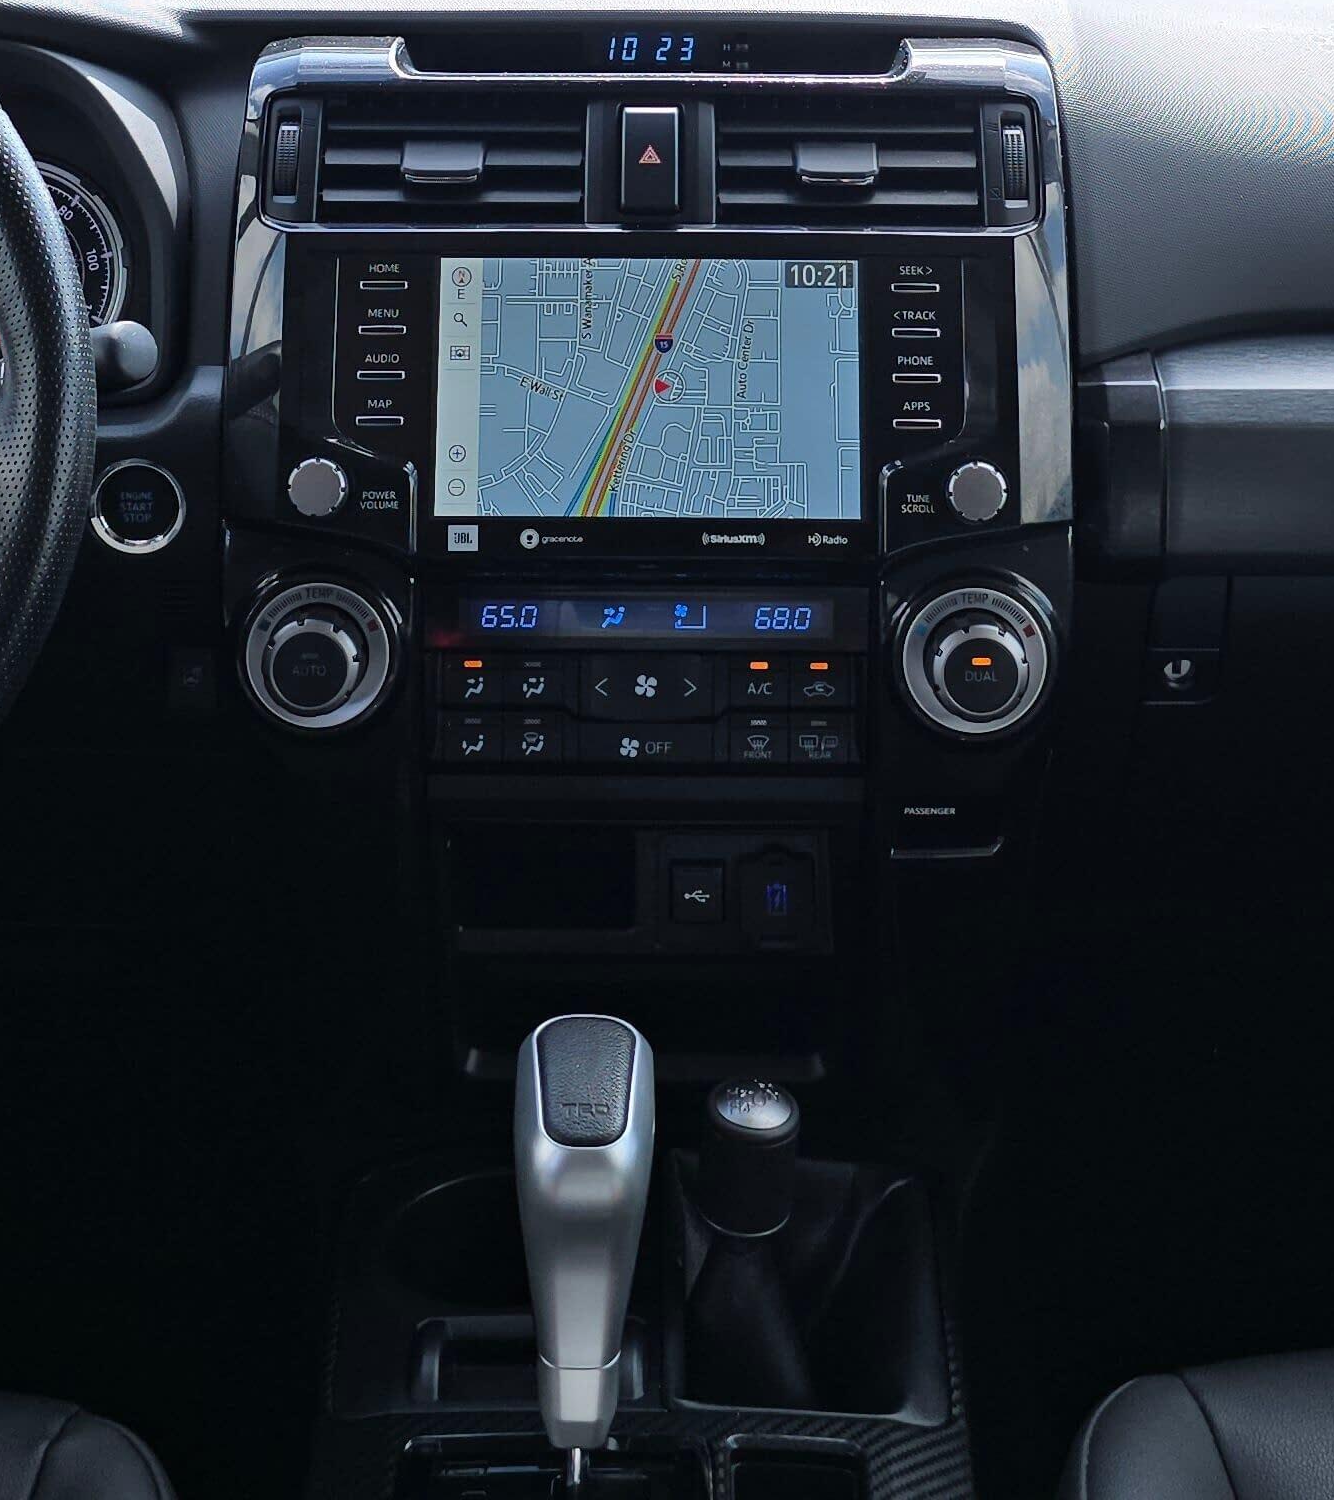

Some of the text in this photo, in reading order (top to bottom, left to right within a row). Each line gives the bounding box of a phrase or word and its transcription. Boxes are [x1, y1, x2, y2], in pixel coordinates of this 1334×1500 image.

[58, 204, 75, 221] 80
[85, 248, 100, 272] 100
[369, 263, 400, 274] HOME
[789, 264, 849, 288] 10:21
[457, 288, 466, 300] E
[581, 269, 594, 330] Wanamaker
[367, 308, 400, 318] MENU
[581, 332, 592, 340] S
[364, 353, 400, 364] AUDIO
[737, 319, 755, 399] Auto Center Dr
[897, 356, 934, 366] PHONE
[520, 377, 564, 401] E Wall St
[367, 399, 393, 409] MAP
[903, 401, 931, 411] APPS
[609, 430, 637, 492] Kettering Dr
[362, 490, 396, 500] POWER
[906, 493, 931, 504] TUNE
[360, 500, 400, 510] VOLUME
[901, 503, 935, 515] SCROLL
[453, 531, 474, 545] JBL
[541, 535, 584, 545] gracenote
[822, 534, 849, 545] Radio
[960, 593, 989, 605] TEMP
[481, 604, 538, 629] 65.0
[754, 606, 812, 630] 68.0
[291, 664, 327, 677] AUTO
[965, 670, 998, 683] DUAL
[747, 682, 773, 696] A/C
[645, 741, 673, 754] OFF
[743, 750, 772, 760] FRONT
[808, 750, 832, 760] REAR
[903, 806, 956, 816] PASSENGER
[555, 1101, 611, 1118] TRD
